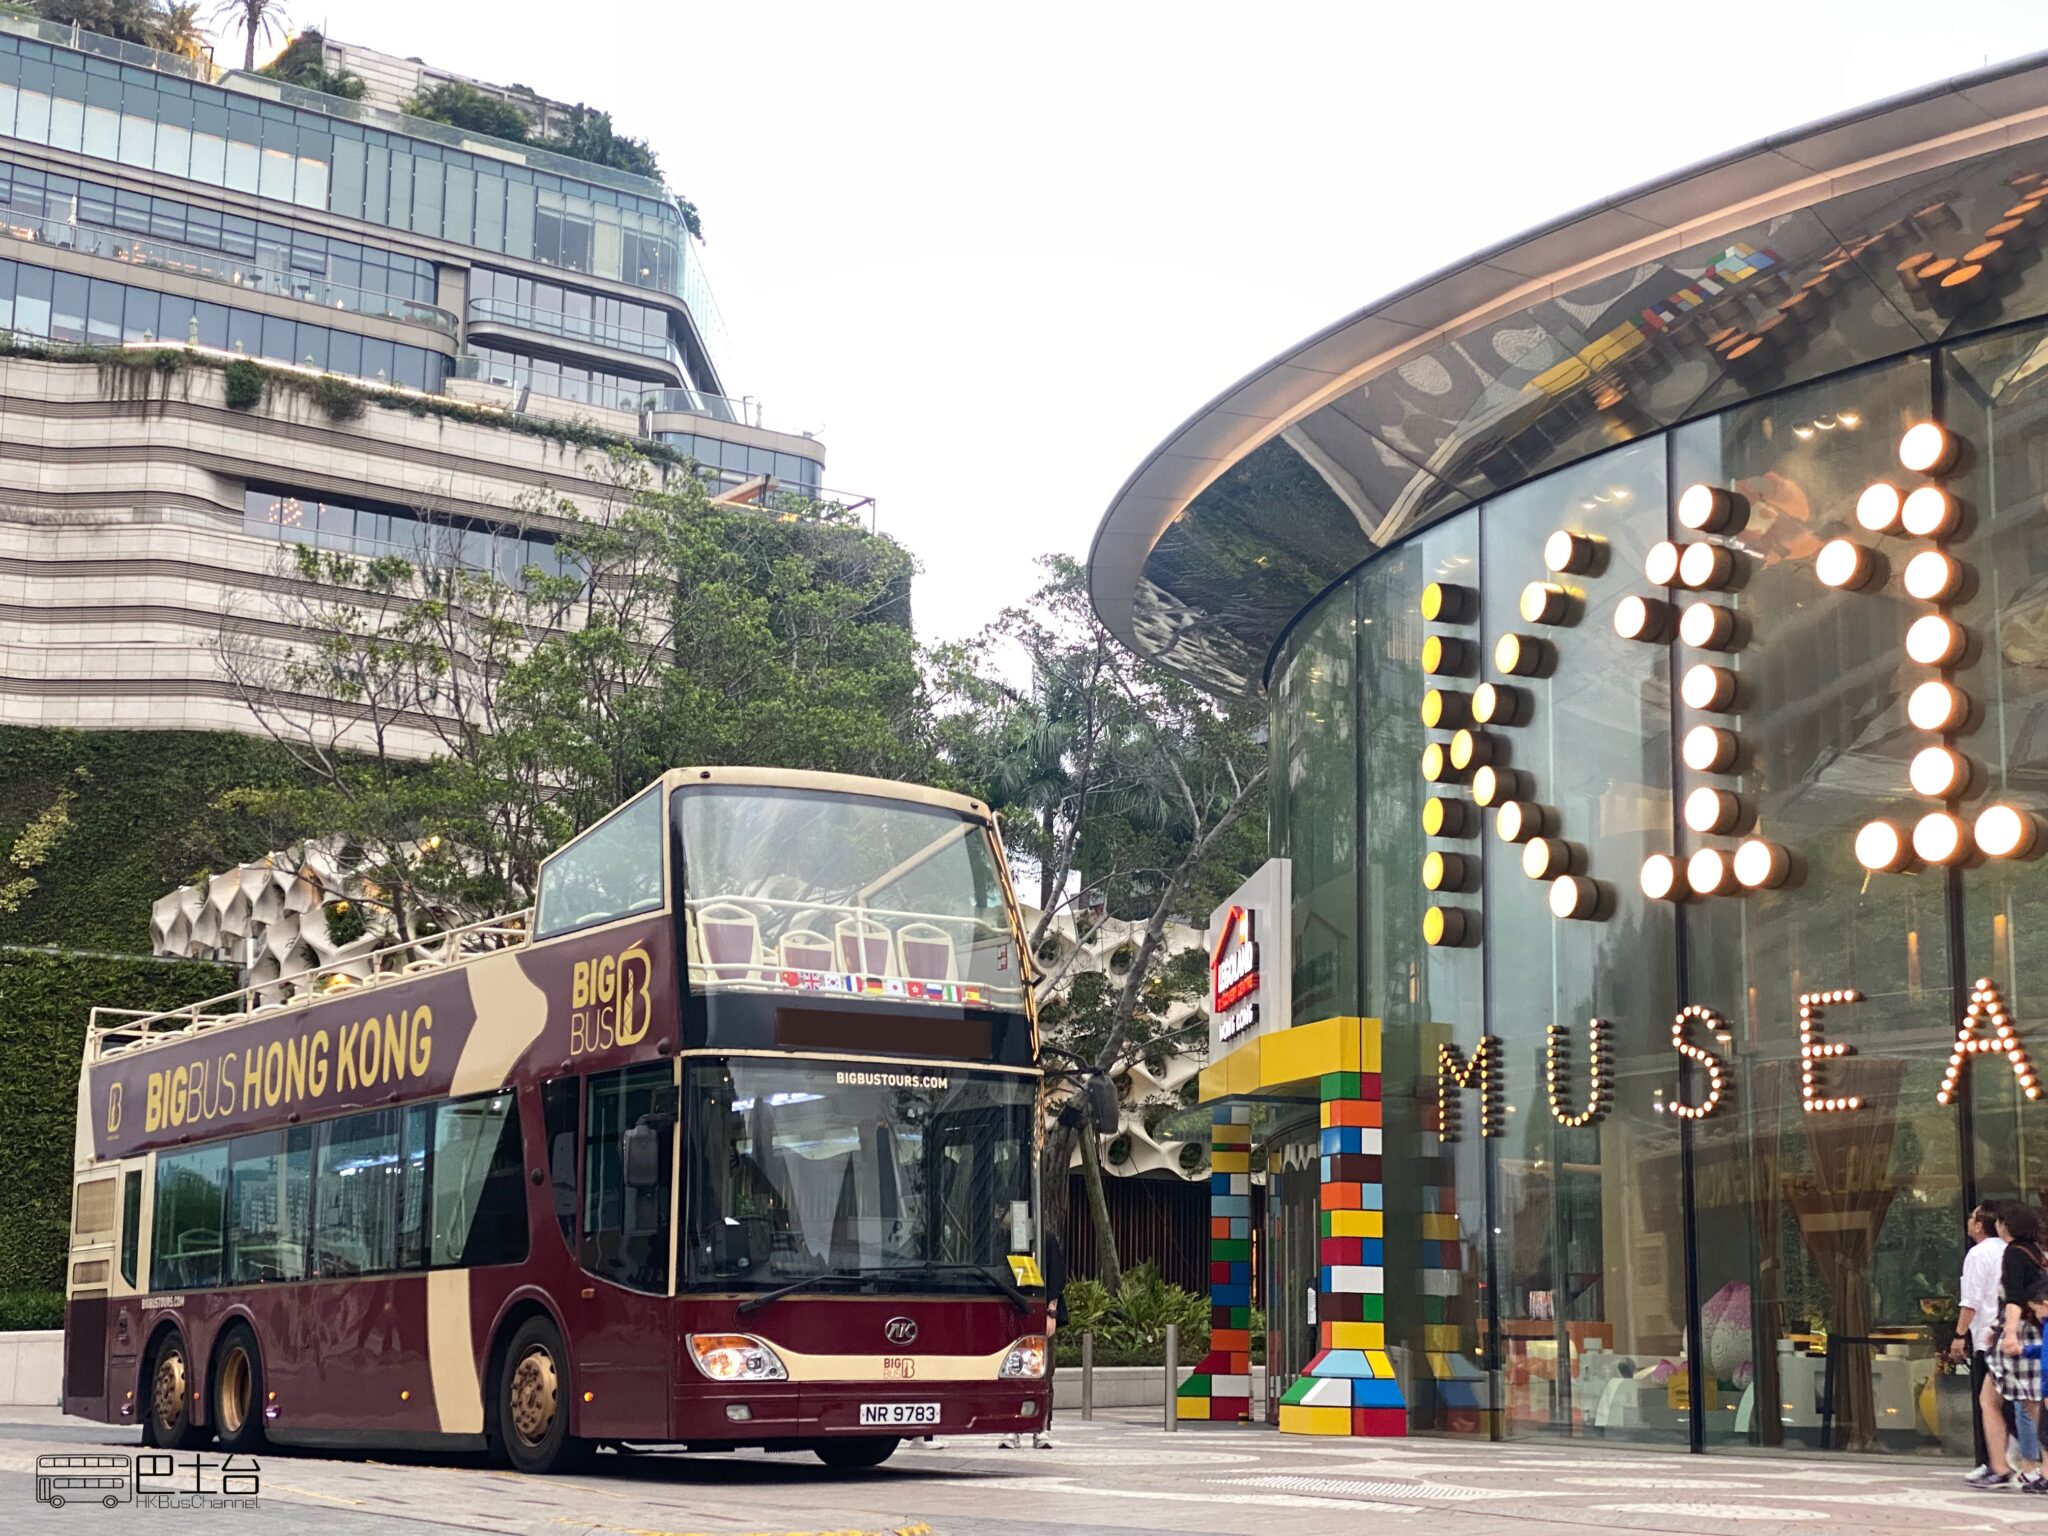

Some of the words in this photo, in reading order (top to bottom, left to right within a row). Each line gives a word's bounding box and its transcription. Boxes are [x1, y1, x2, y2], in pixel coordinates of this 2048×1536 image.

[1420, 421, 2037, 948] K11
[572, 954, 616, 1010] BIG
[570, 1006, 614, 1056] BUS
[242, 1030, 329, 1113] HONG
[336, 1004, 433, 1093] KONG
[836, 1072, 948, 1090] BIGBUSTOURS.COM
[1437, 977, 2041, 1143] MUSEA
[883, 1358, 901, 1369] BIG
[883, 1369, 901, 1379] BUS
[865, 1406, 888, 1423] NR
[893, 1406, 936, 1423] 9783
